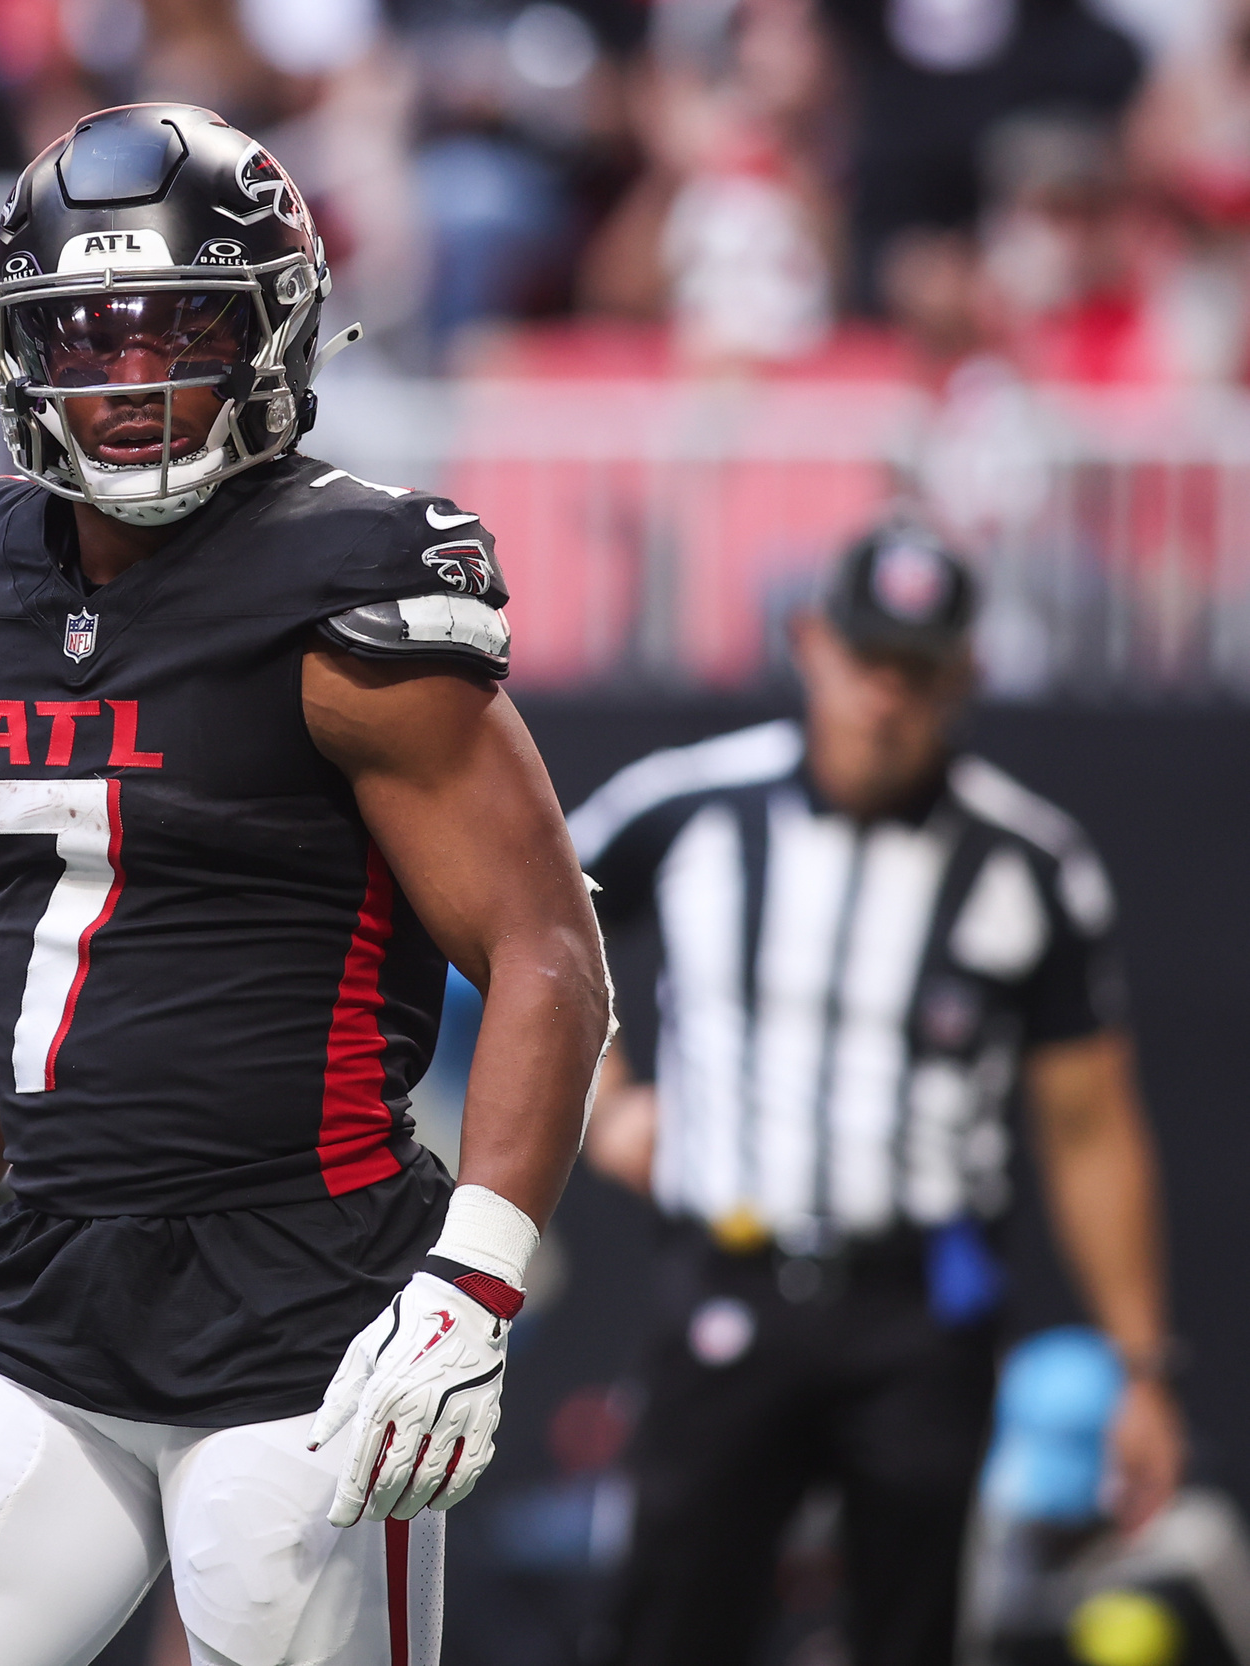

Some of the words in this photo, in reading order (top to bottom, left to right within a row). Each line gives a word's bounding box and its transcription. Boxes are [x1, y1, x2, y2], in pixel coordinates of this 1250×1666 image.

[84, 234, 142, 254] ATL
[200, 256, 250, 267] OAKLEY
[68, 633, 90, 654] NFL
